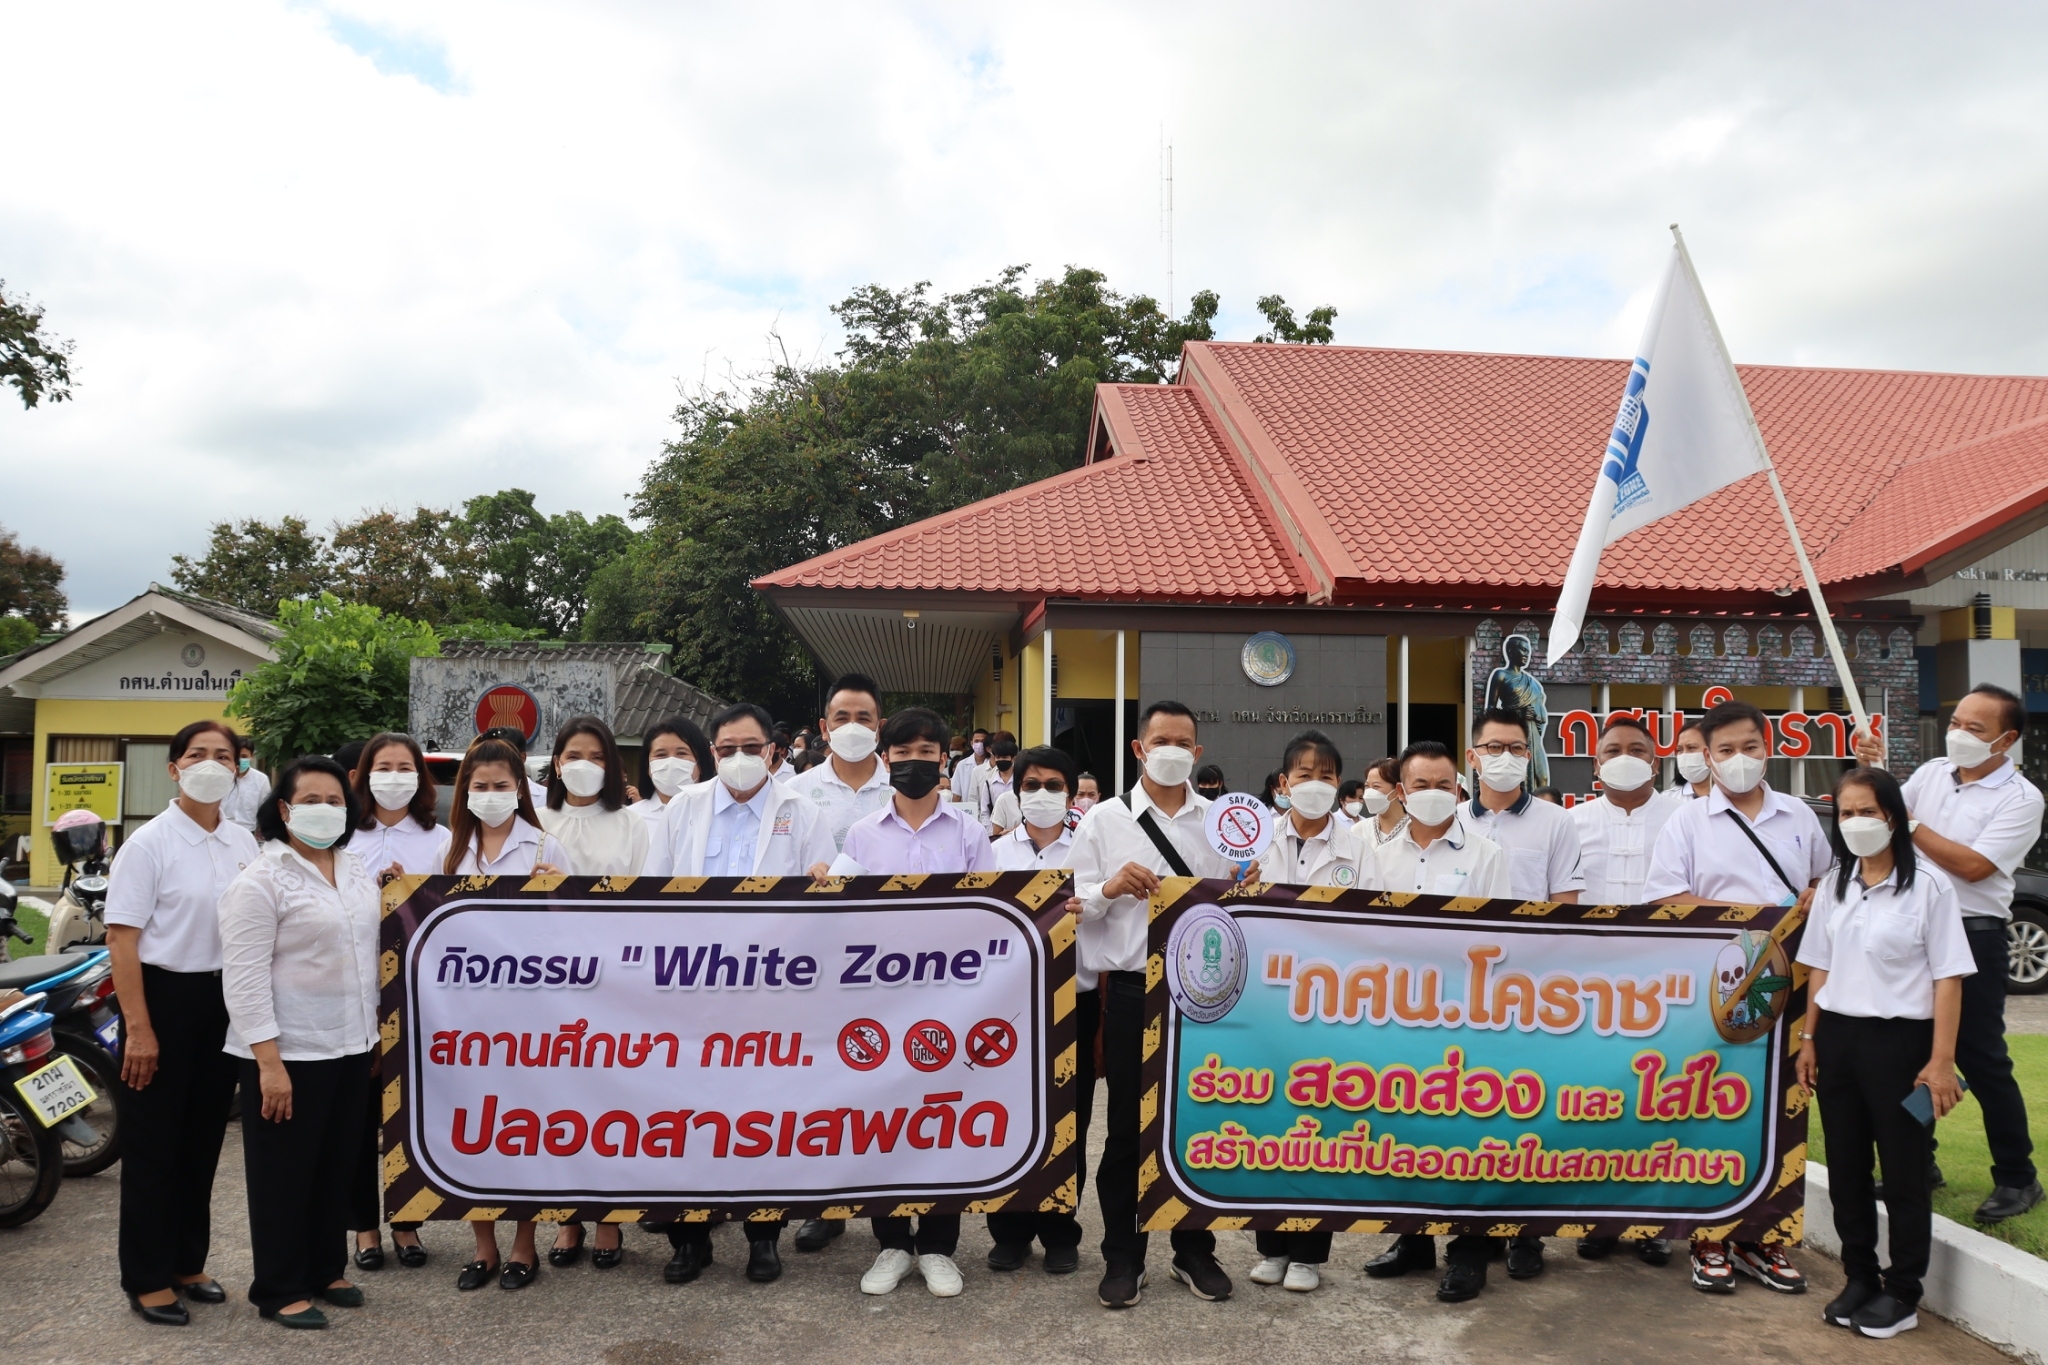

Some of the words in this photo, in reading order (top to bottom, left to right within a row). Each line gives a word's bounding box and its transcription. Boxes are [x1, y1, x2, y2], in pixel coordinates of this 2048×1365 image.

[1228, 796, 1245, 805] SAY
[1246, 799, 1259, 810] NO
[1217, 842, 1228, 853] TO
[1228, 847, 1256, 858] DRUGS
[436, 946, 599, 985] กิจกรรม
[621, 943, 817, 987] "White
[839, 939, 1010, 985] Zone"
[1267, 944, 1690, 1031] "กศน.โคราช"
[429, 1018, 680, 1068] สถานศึกษา
[700, 1030, 813, 1067] กศน.
[46, 1091, 87, 1118] 7203
[1191, 1057, 1270, 1100] ร่วม
[1289, 1049, 1542, 1115] สอดส่อง
[1560, 1088, 1620, 1117] และ
[1635, 1053, 1748, 1118] ใส่ใจ
[451, 1091, 1009, 1158] ปลอดสารเสพติด
